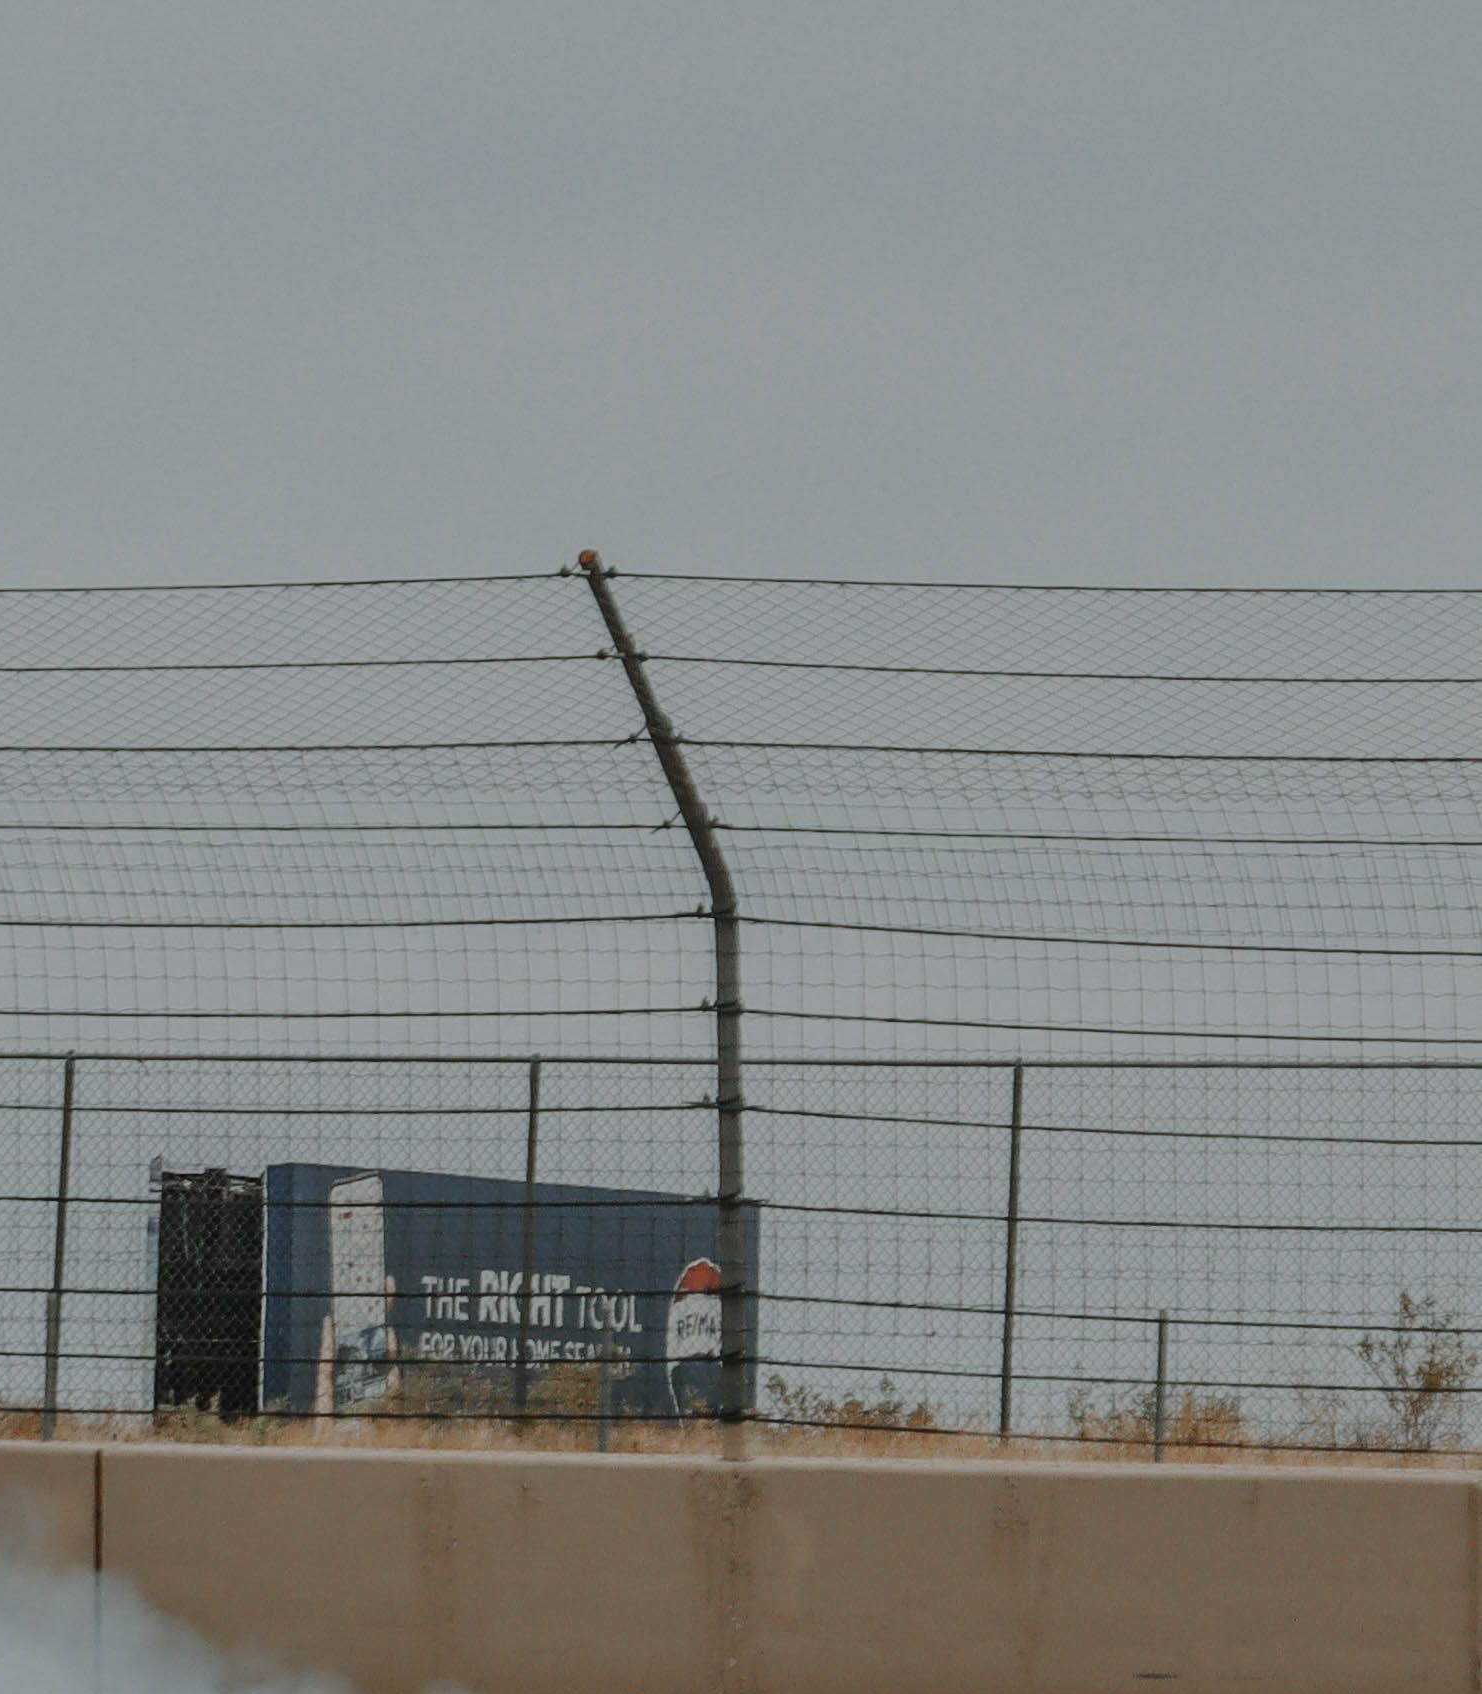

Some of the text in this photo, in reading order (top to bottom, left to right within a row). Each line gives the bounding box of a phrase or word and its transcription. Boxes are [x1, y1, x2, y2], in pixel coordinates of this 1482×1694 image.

[421, 1269, 643, 1333] THE RIGHT TOOL
[419, 1331, 455, 1361] FOR
[459, 1334, 507, 1368] YOUR
